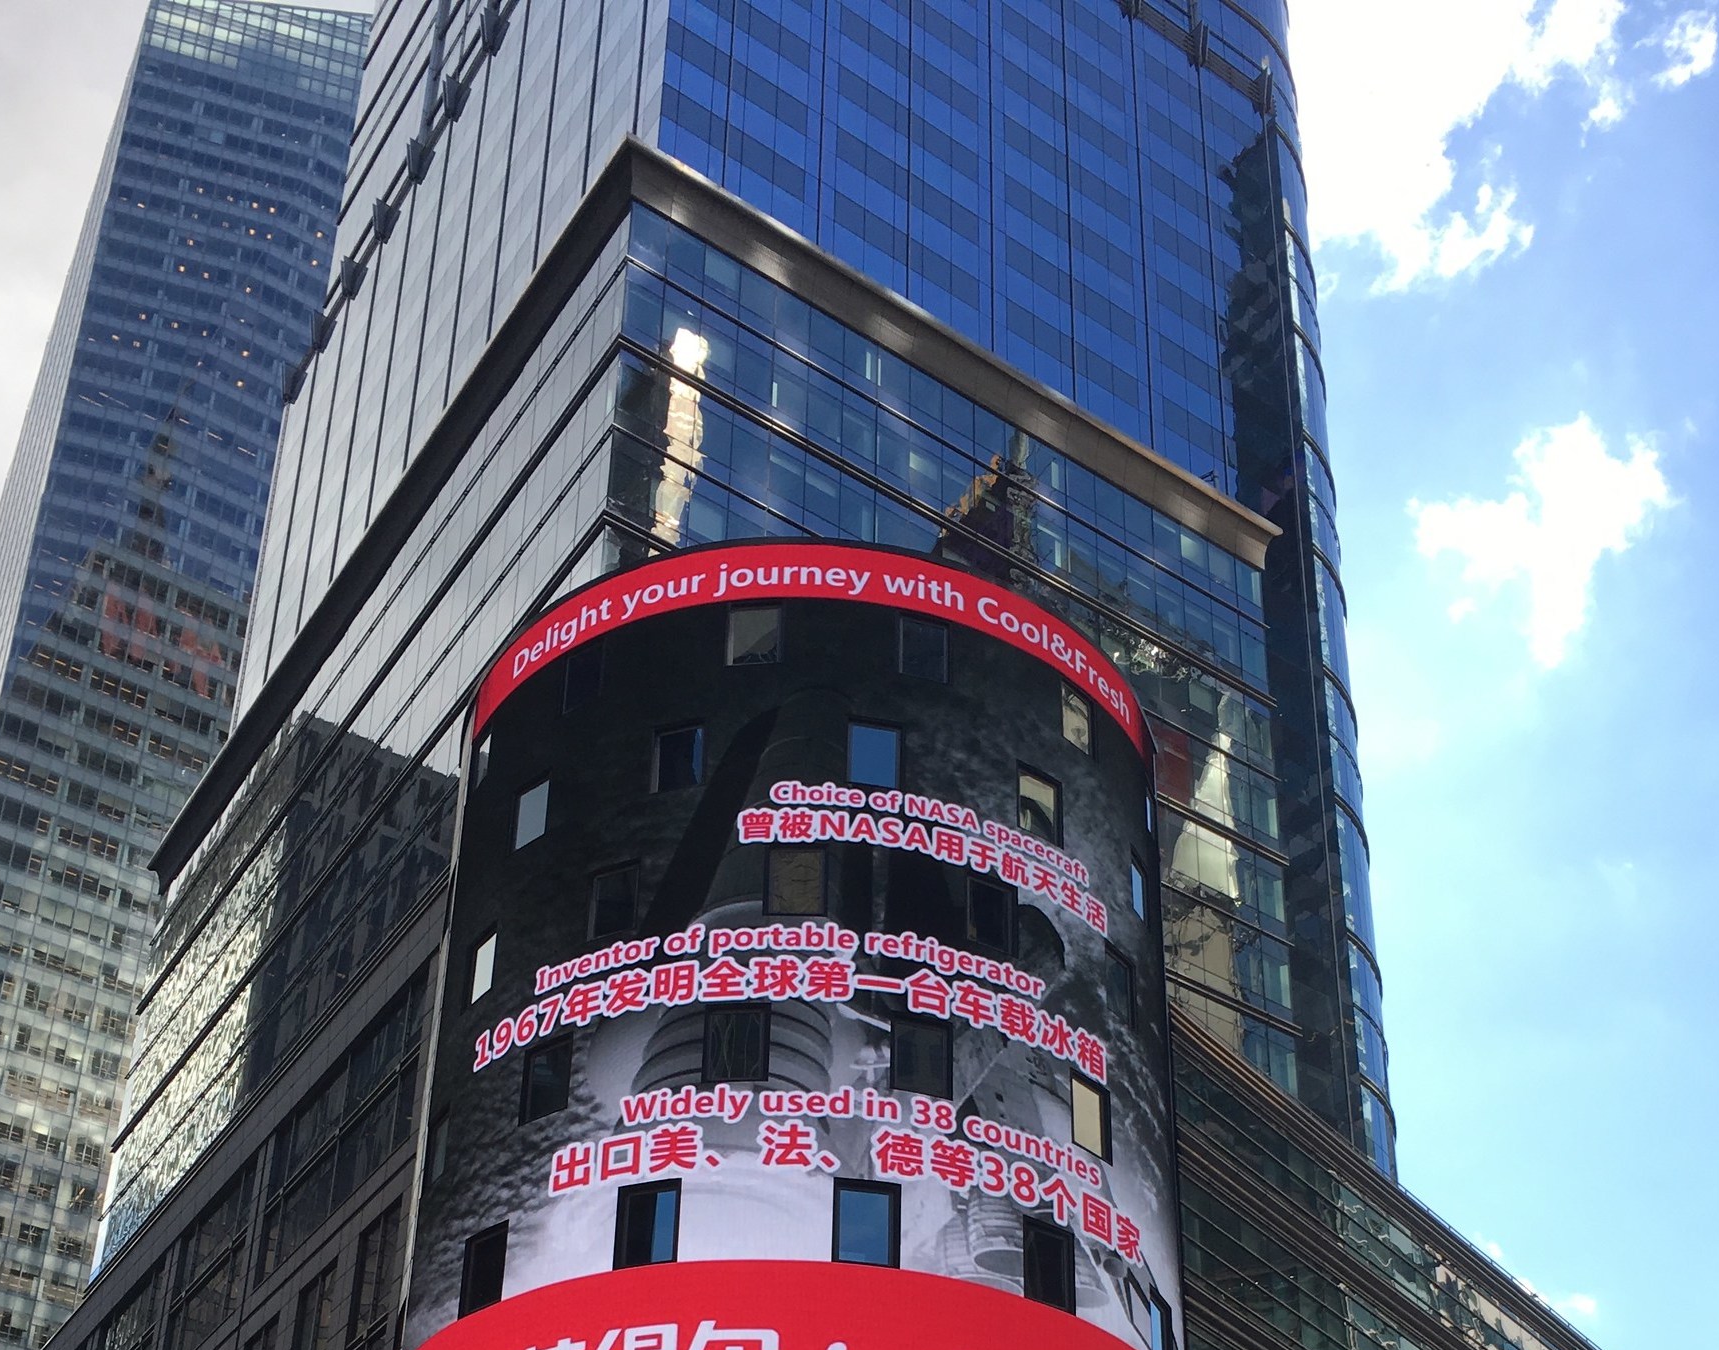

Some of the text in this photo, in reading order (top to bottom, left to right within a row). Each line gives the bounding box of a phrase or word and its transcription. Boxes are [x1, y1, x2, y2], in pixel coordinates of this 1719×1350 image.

[512, 562, 1132, 725] Delight your journey with Cool&Fresh
[771, 781, 1089, 885] Choice of NASA spacecraft
[536, 924, 1045, 998] Inventor of portable refrigerator
[474, 956, 1107, 1082] 1967年发明全球第一台车载冰箱
[622, 1086, 1102, 1187] Widely used in 38 countries
